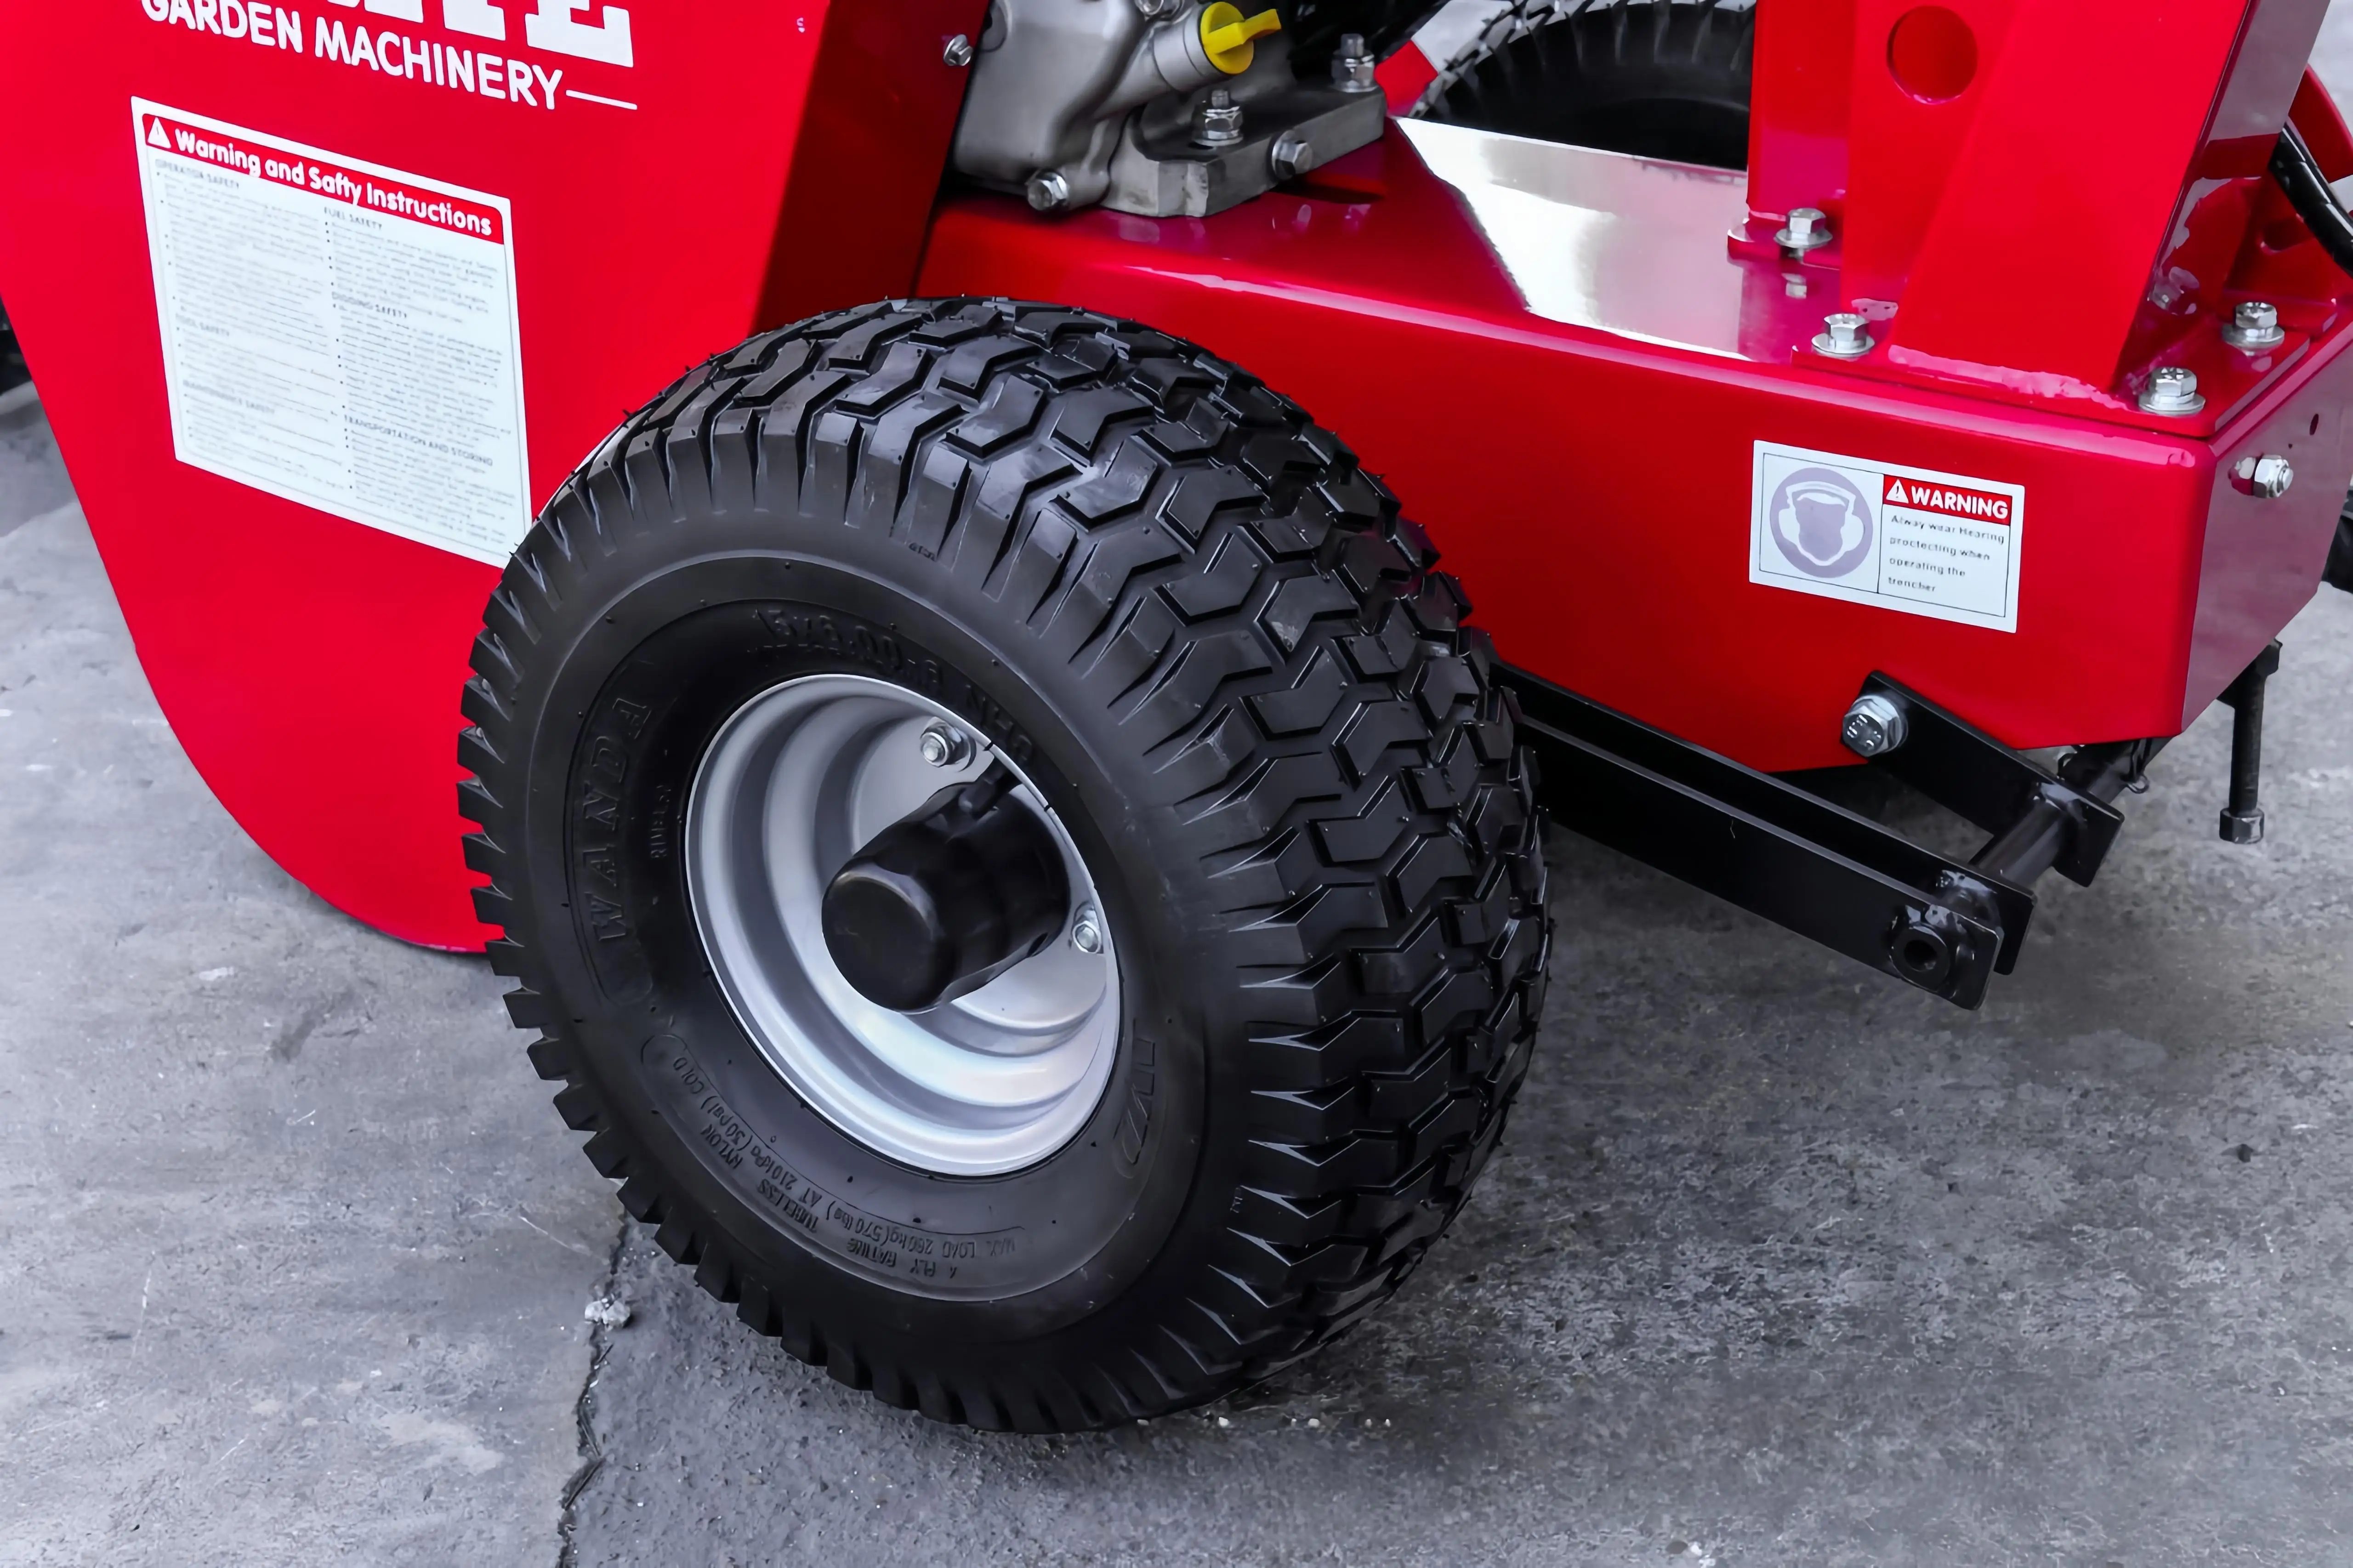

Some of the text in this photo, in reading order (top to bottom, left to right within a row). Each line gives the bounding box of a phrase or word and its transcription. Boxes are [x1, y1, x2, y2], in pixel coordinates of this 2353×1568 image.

[315, 17, 563, 110] MACHINERY
[175, 128, 492, 236] Warning and Safty Instructions
[350, 214, 382, 230] SAFETY
[1911, 485, 2008, 520] WARNING
[1928, 523, 1955, 533] wear
[1959, 526, 2005, 545] Hearing
[1889, 557, 1966, 576] operating the
[1960, 549, 1990, 561] when
[1887, 577, 1936, 592] trencher
[582, 698, 652, 942] WANDA
[673, 1057, 705, 1095] COLD
[700, 1124, 743, 1170] NYLON
[798, 1187, 823, 1208] AT
